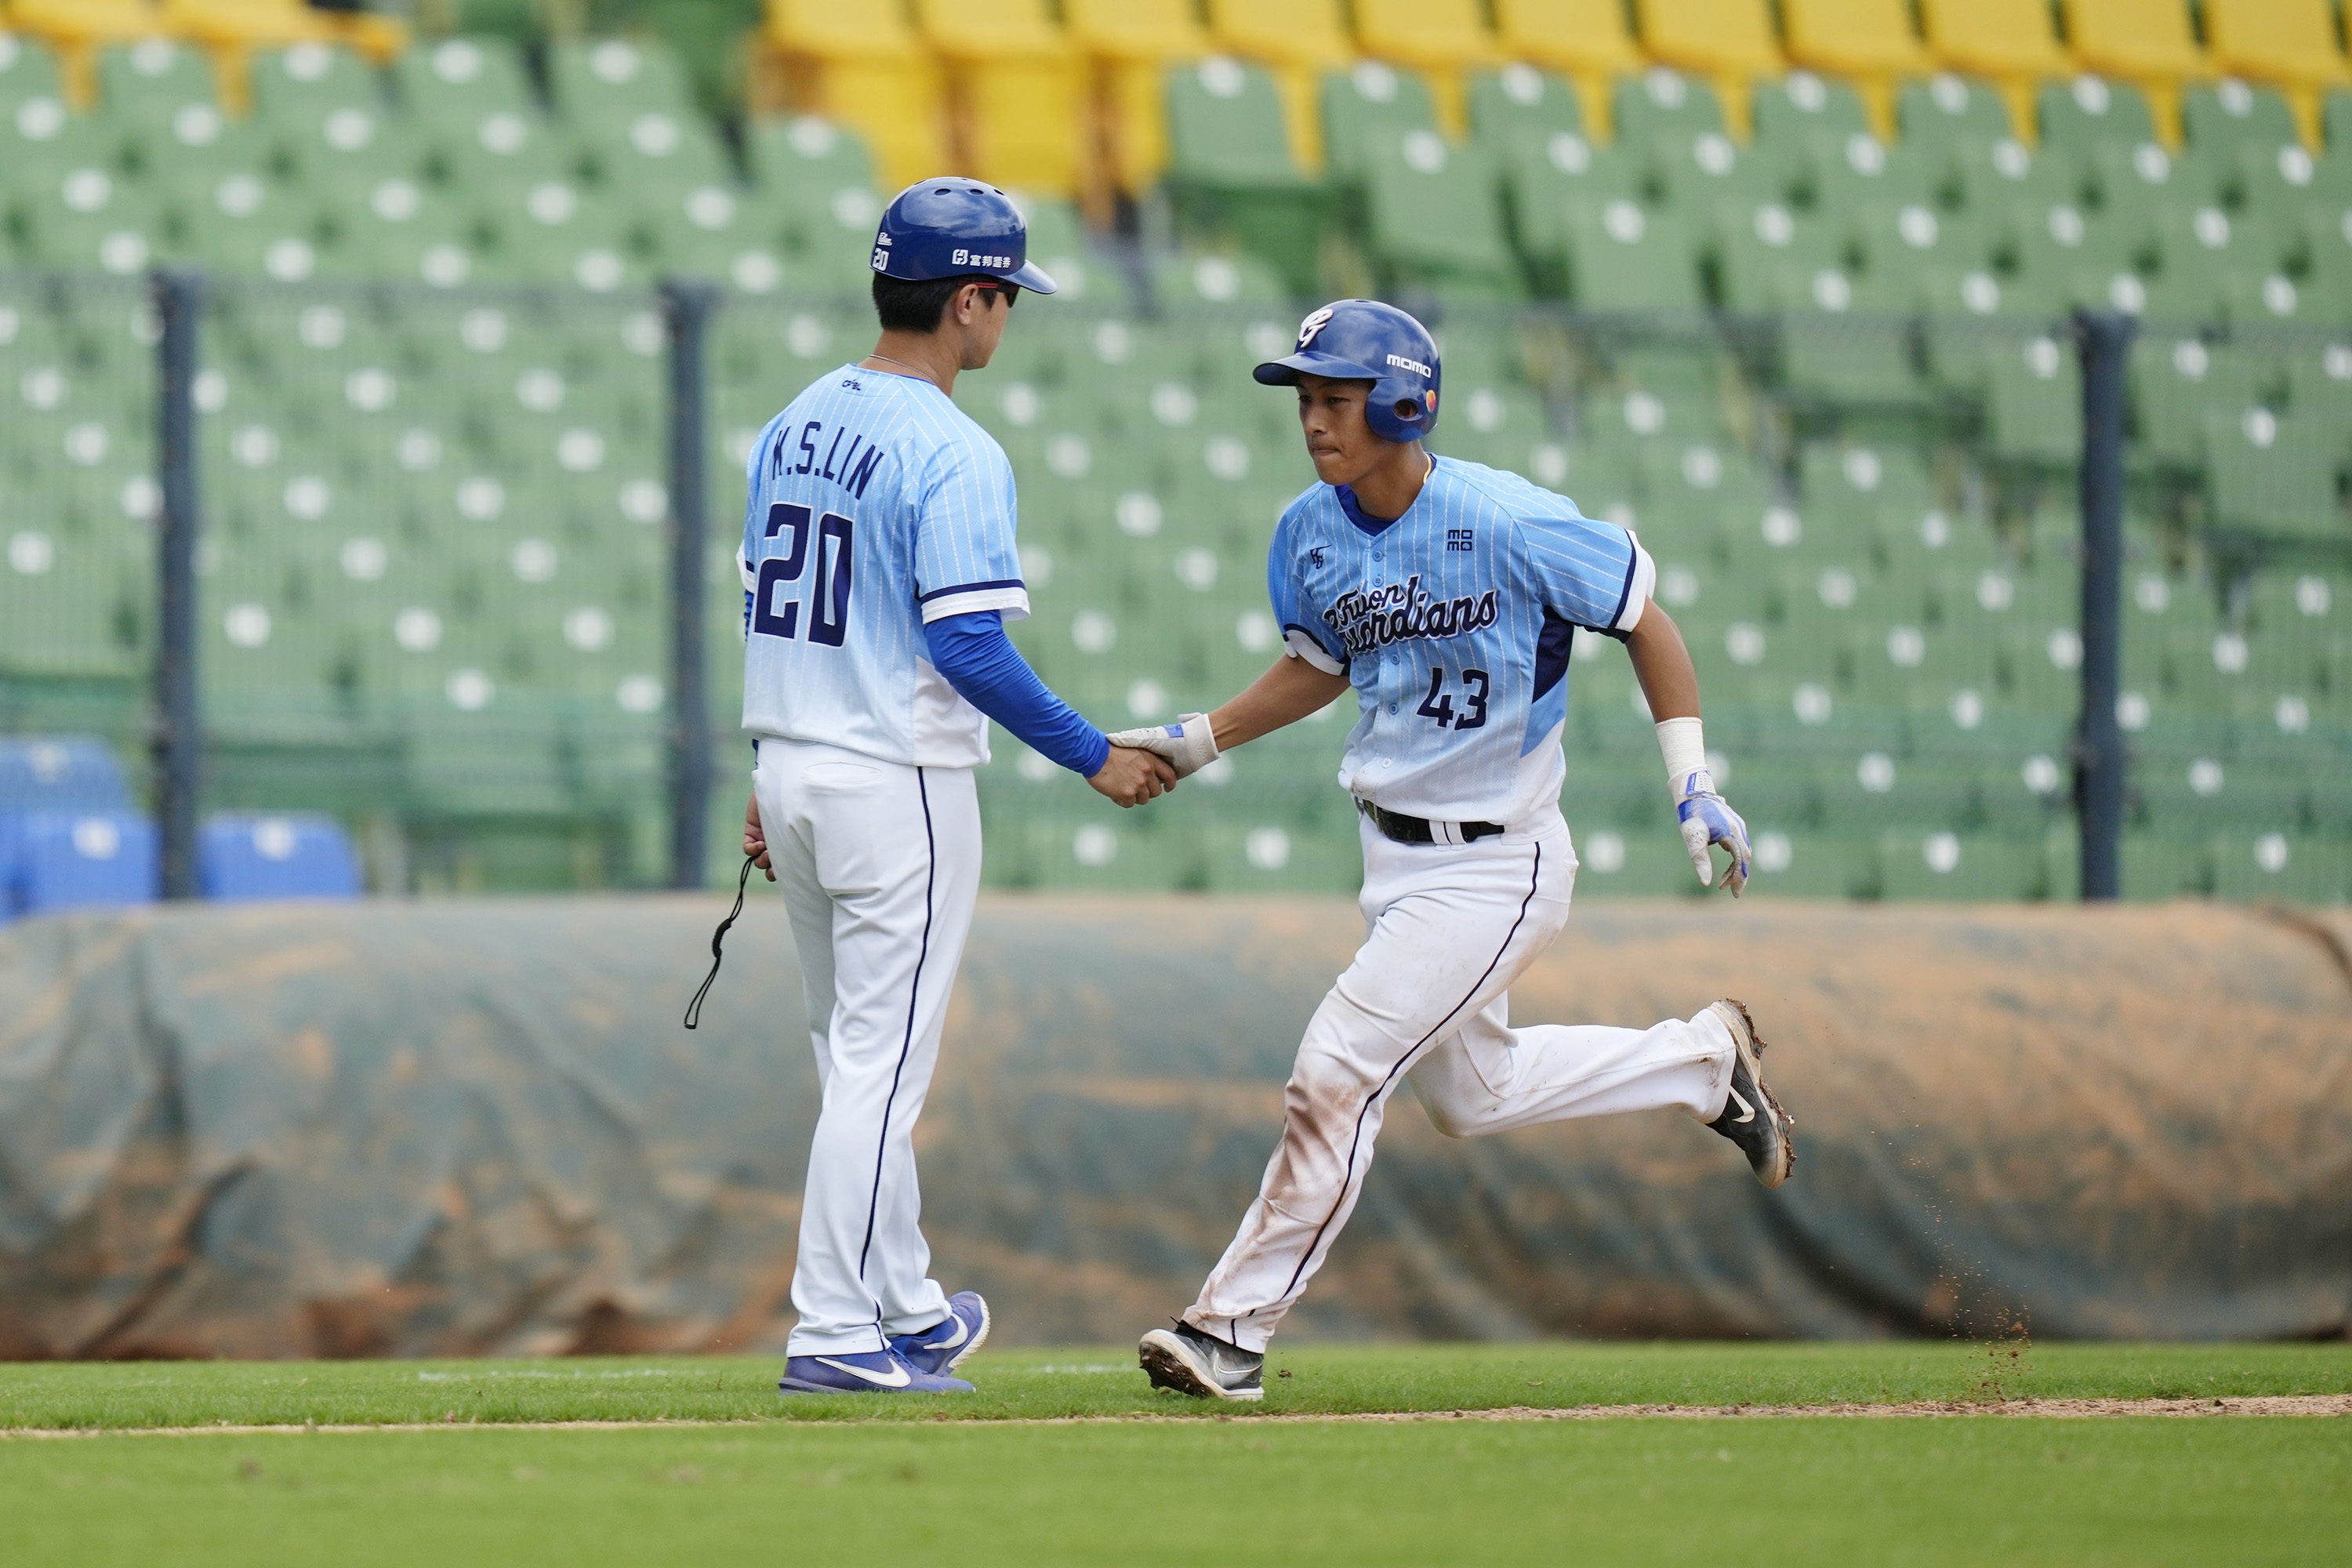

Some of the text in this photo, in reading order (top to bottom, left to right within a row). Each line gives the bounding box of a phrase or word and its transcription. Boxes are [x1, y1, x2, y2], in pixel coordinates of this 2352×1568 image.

[772, 421, 884, 500] K.S.LIN
[753, 501, 855, 648] 20
[1416, 666, 1490, 731] 43
